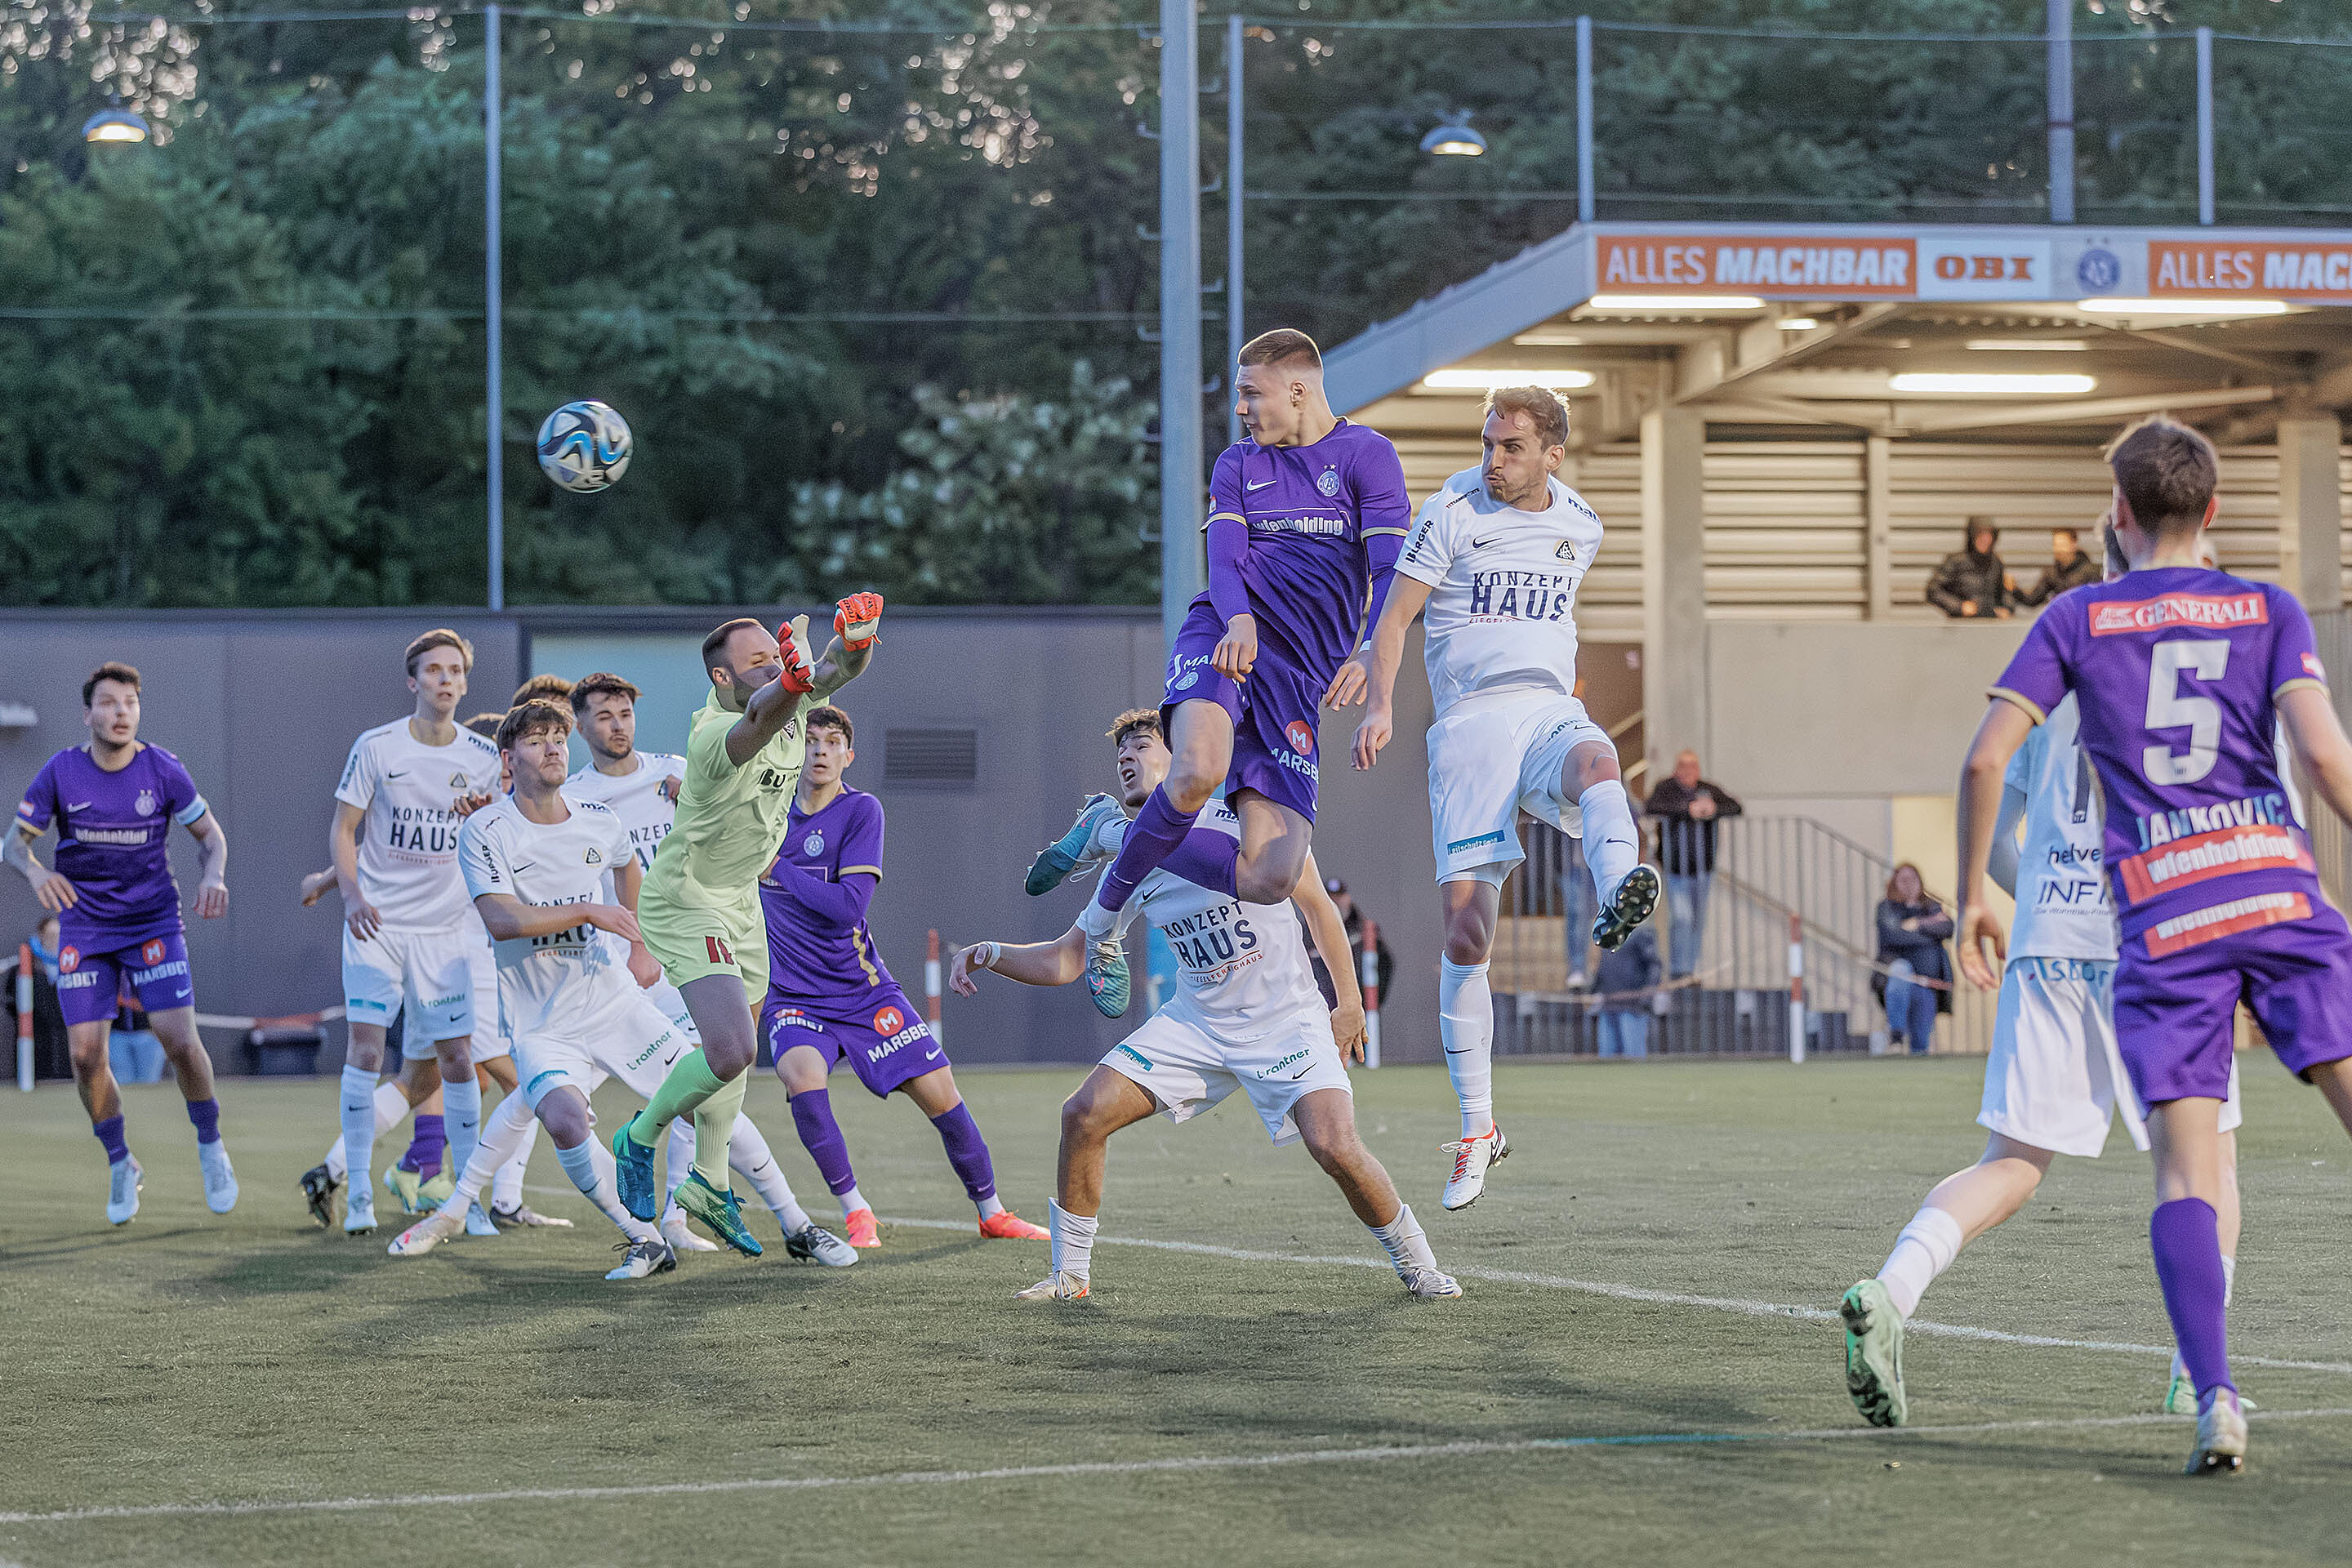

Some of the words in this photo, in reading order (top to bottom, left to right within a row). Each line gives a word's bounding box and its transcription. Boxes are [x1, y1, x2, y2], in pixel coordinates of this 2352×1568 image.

[1606, 246, 1707, 284] ALLES
[1716, 247, 1909, 287] MACHBAR
[1935, 254, 2034, 281] OBI
[2158, 250, 2254, 289] ALLES
[2263, 252, 2352, 291] MAC
[1470, 586, 1567, 621] HAUS
[2135, 598, 2259, 627] GENERALI
[2143, 639, 2231, 786] 5
[390, 822, 457, 852] HAUS
[2136, 793, 2286, 853] JANKOVIC
[2047, 844, 2102, 865] helve
[2147, 831, 2299, 884] wienholding
[1162, 898, 1245, 938] KONZEPT
[1174, 920, 1258, 969] HAUS
[866, 1022, 929, 1062] MARSBE
